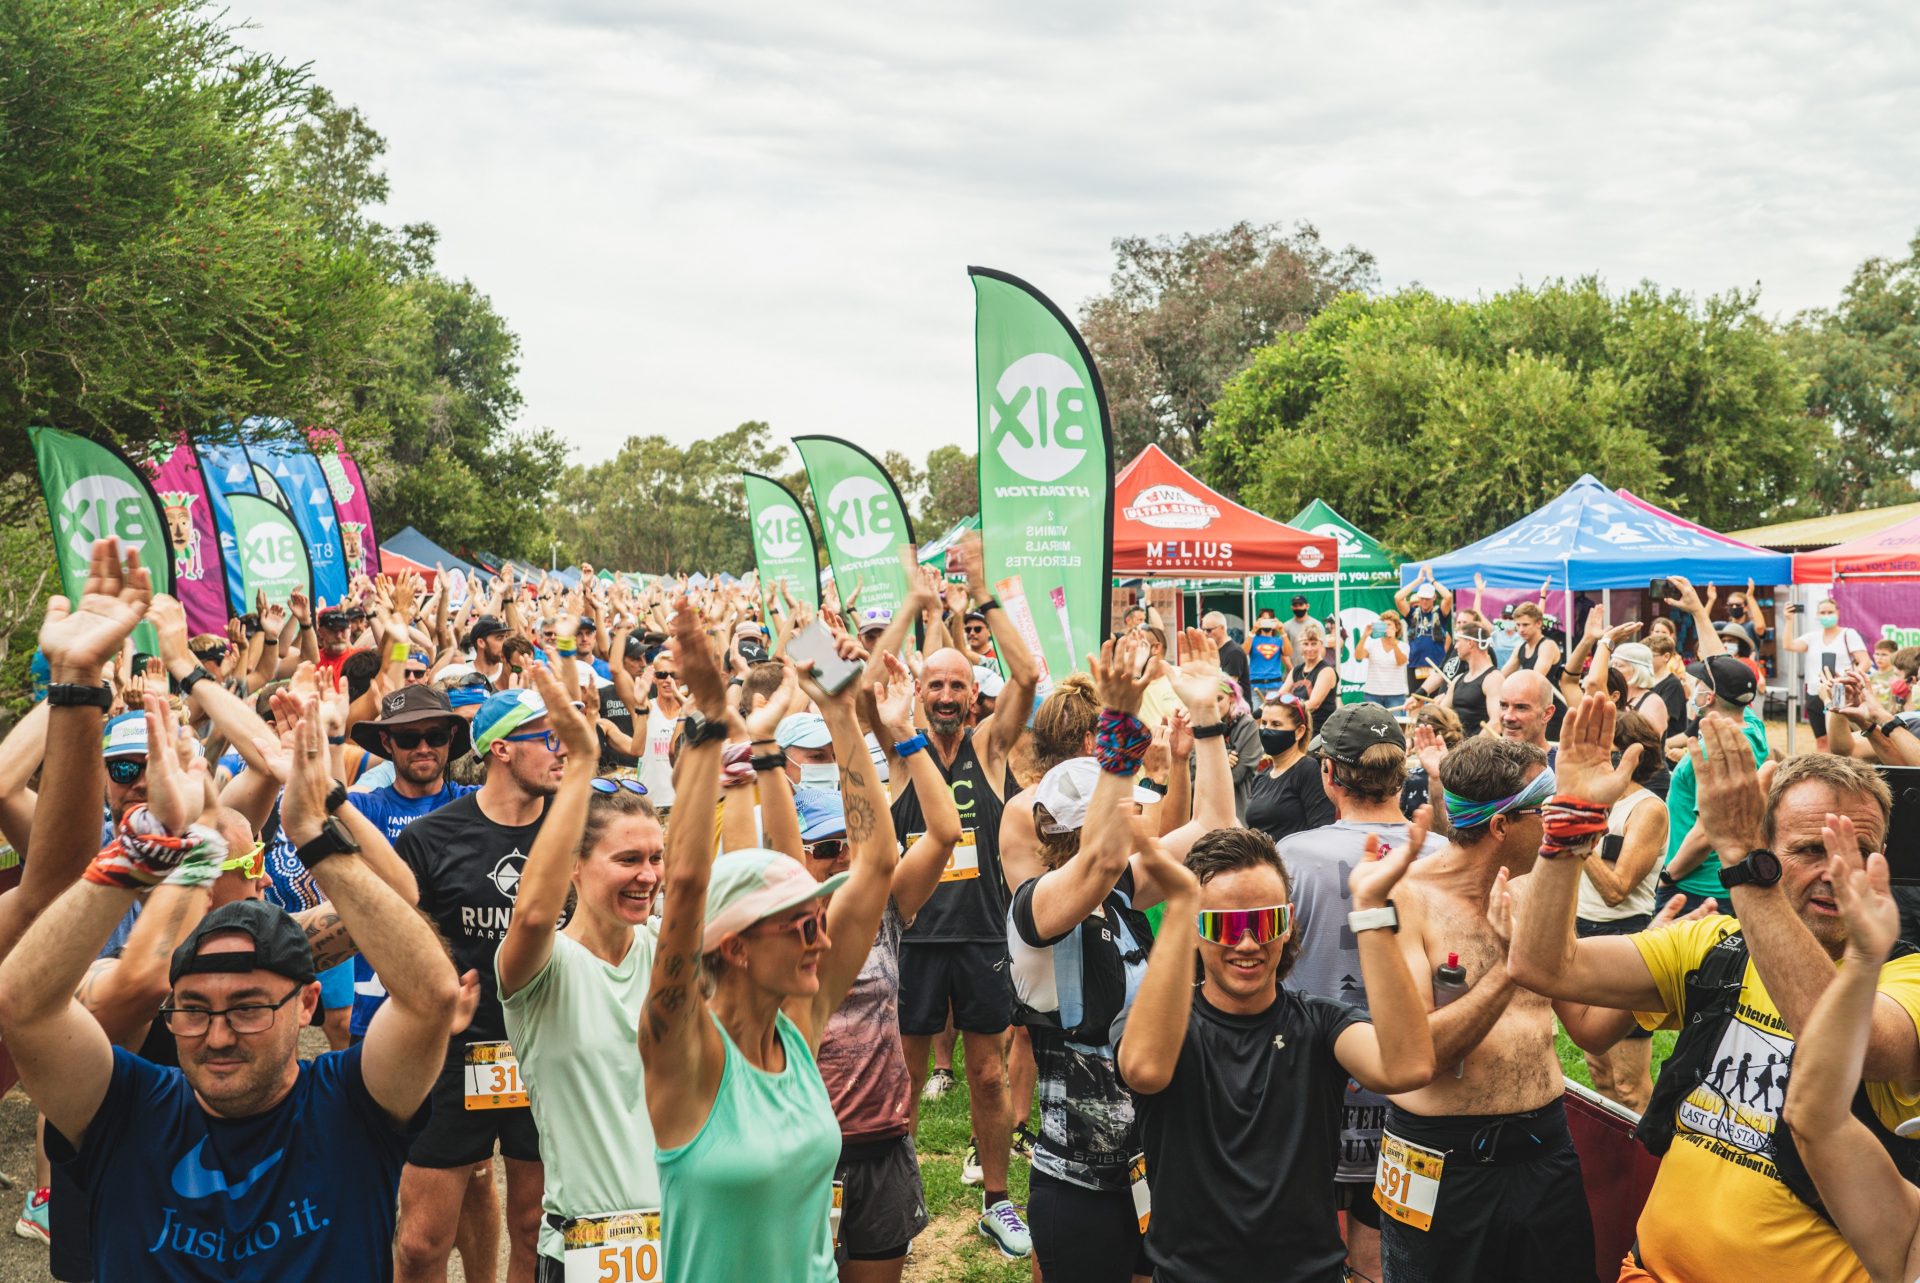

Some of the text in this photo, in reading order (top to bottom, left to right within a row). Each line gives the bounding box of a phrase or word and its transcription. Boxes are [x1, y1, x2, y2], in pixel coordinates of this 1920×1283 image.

[1127, 504, 1169, 519] ULTRA
[1146, 541, 1233, 559] MELIUS
[1146, 559, 1233, 567] CONSULTING
[1348, 571, 1369, 583] you
[1371, 571, 1392, 580] can
[1682, 1105, 1708, 1126] LAST
[1708, 1118, 1735, 1136] ONE
[1736, 1154, 1763, 1173] about
[1381, 1161, 1411, 1204] 591
[149, 1197, 331, 1262] Just do it.
[598, 1244, 658, 1283] 510
